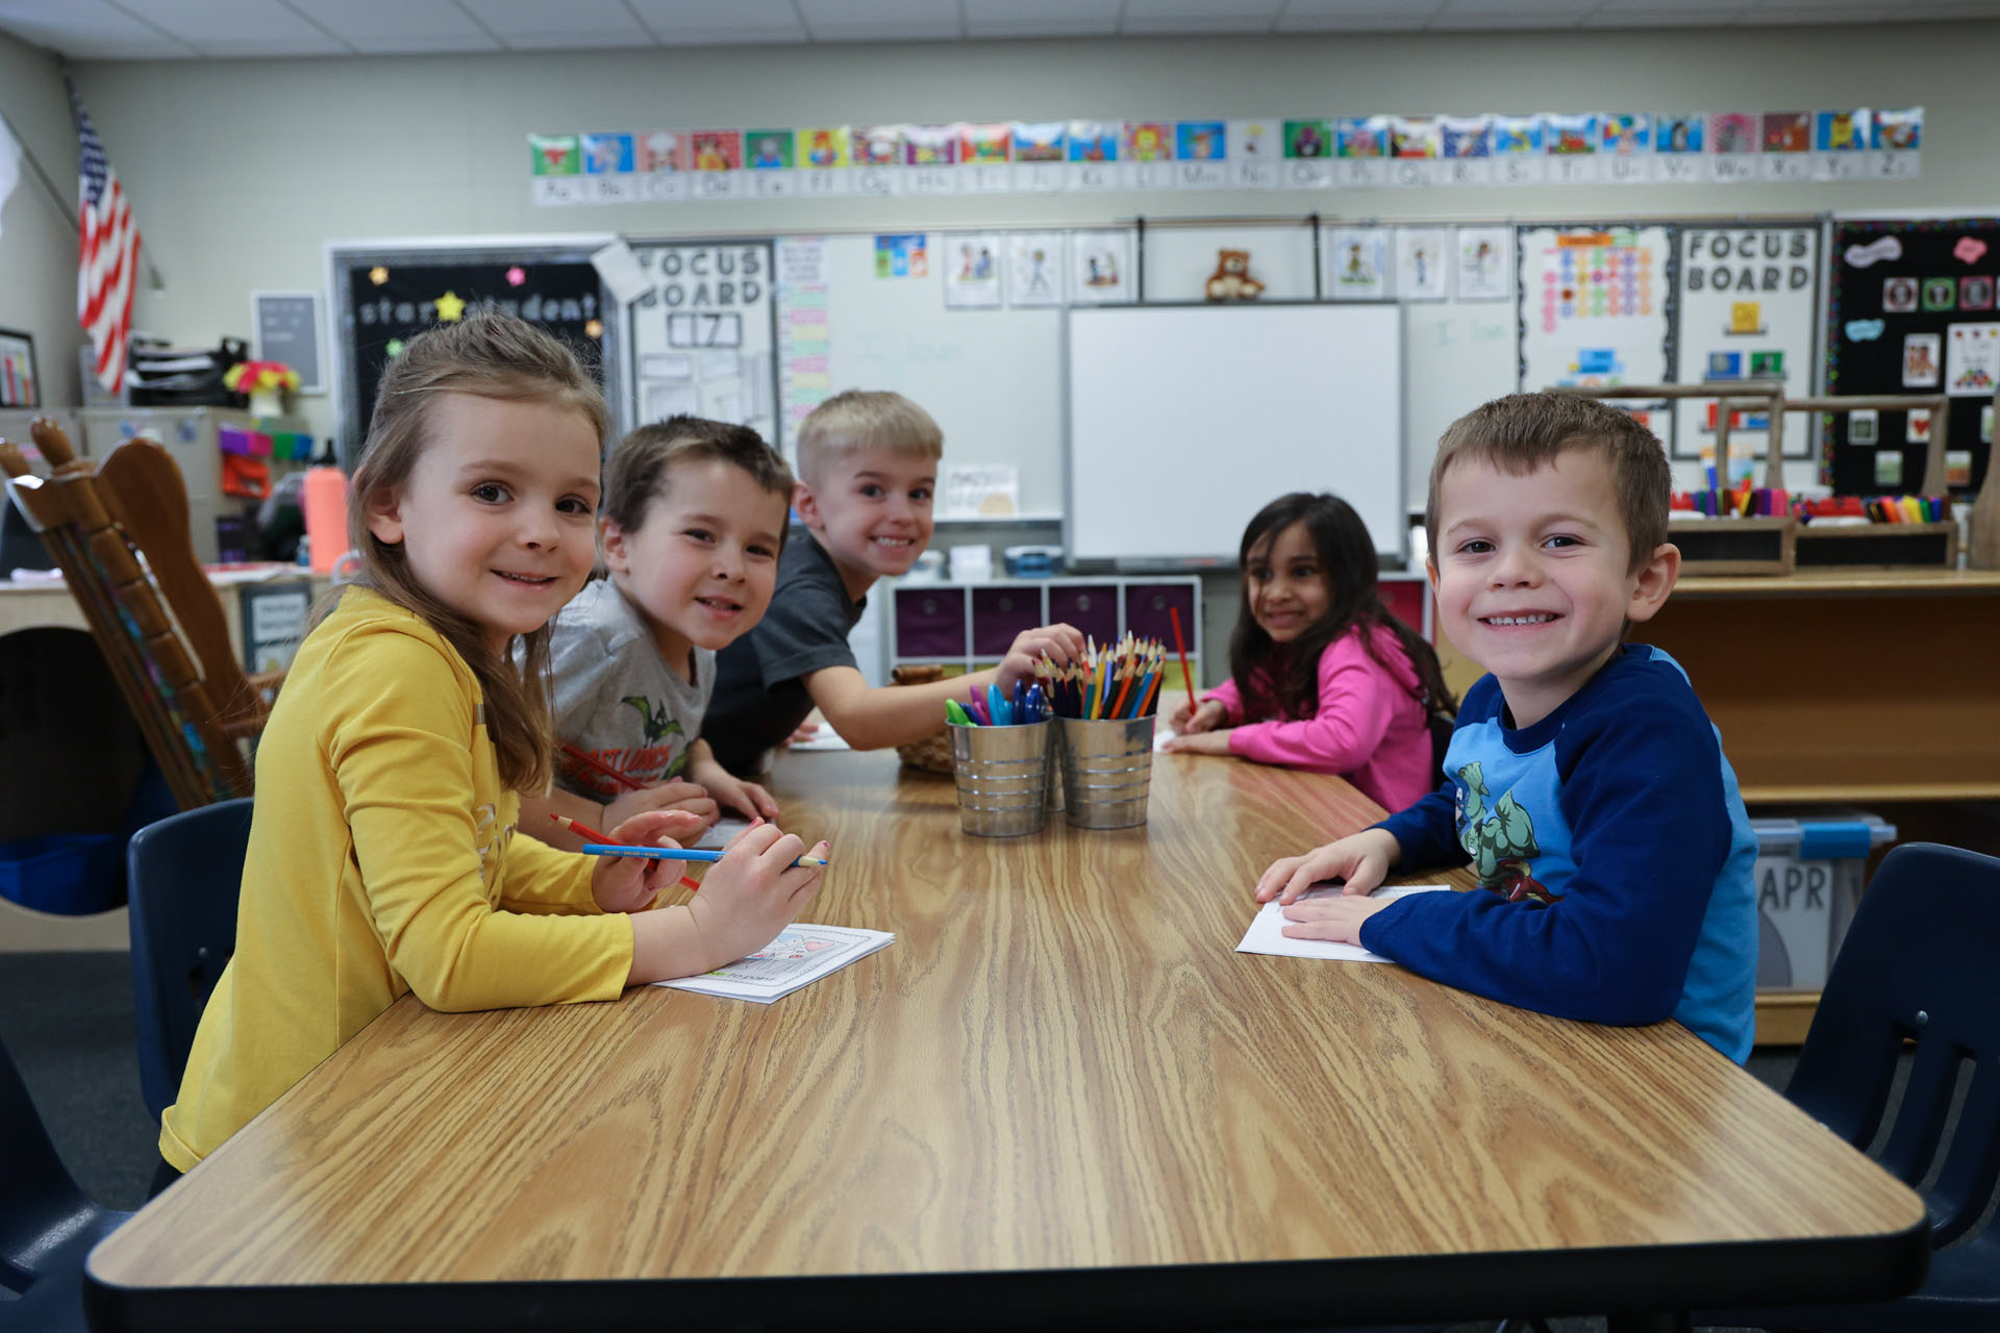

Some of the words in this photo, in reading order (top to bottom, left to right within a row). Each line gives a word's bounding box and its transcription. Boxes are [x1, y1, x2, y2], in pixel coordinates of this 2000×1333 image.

[1689, 233, 1807, 259] FOCUS
[1688, 266, 1809, 292] BOARD
[640, 281, 761, 308] BOARD
[1759, 866, 1826, 911] APR
